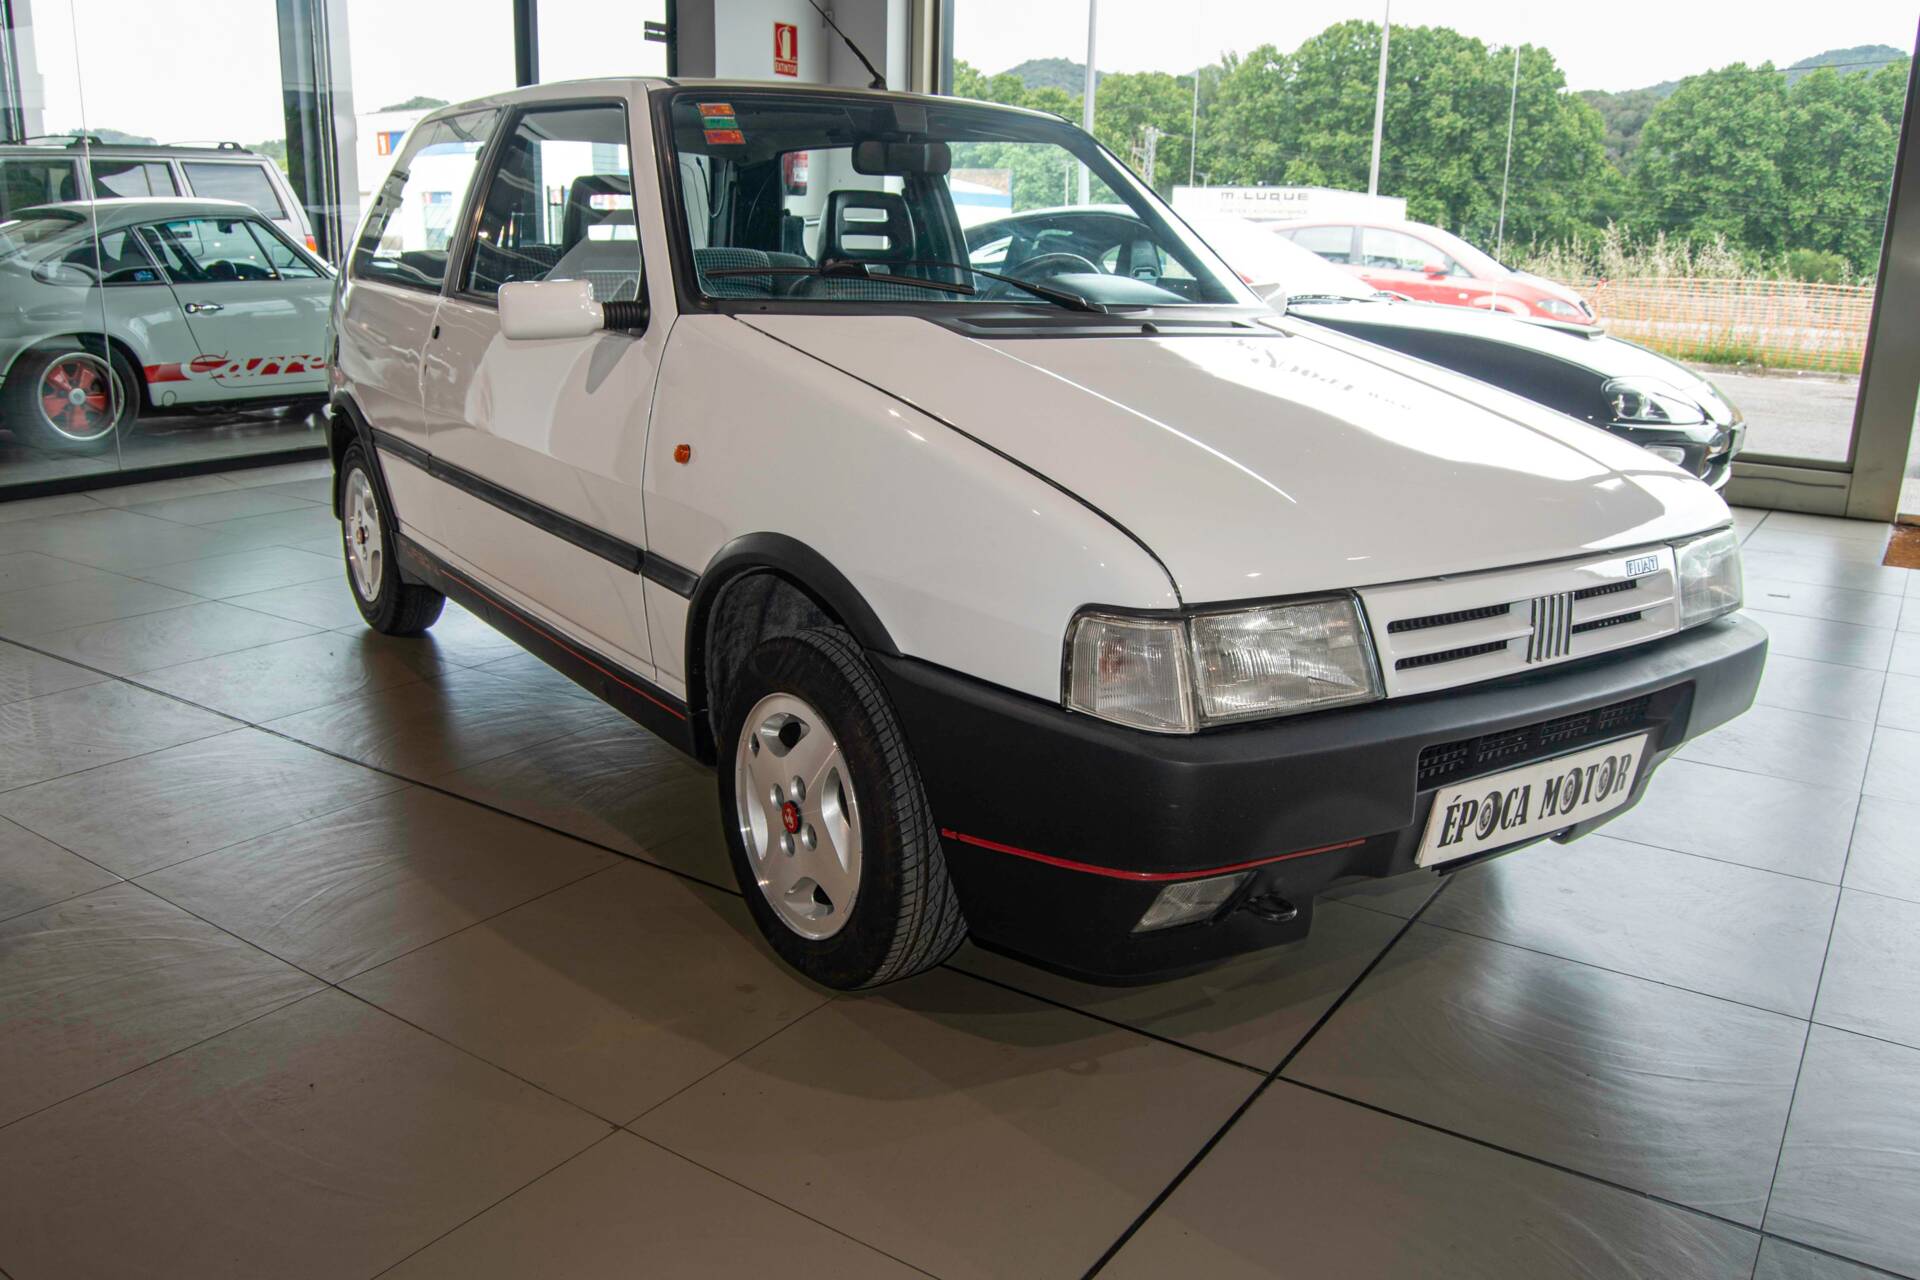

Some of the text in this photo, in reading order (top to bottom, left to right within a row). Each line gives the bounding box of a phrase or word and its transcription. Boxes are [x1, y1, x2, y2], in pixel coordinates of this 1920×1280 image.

[1243, 192, 1309, 201] LUQUE
[181, 351, 327, 381] Carre
[1627, 556, 1657, 575] FIAT
[1437, 753, 1633, 848] ÉPOCA MOTOR
